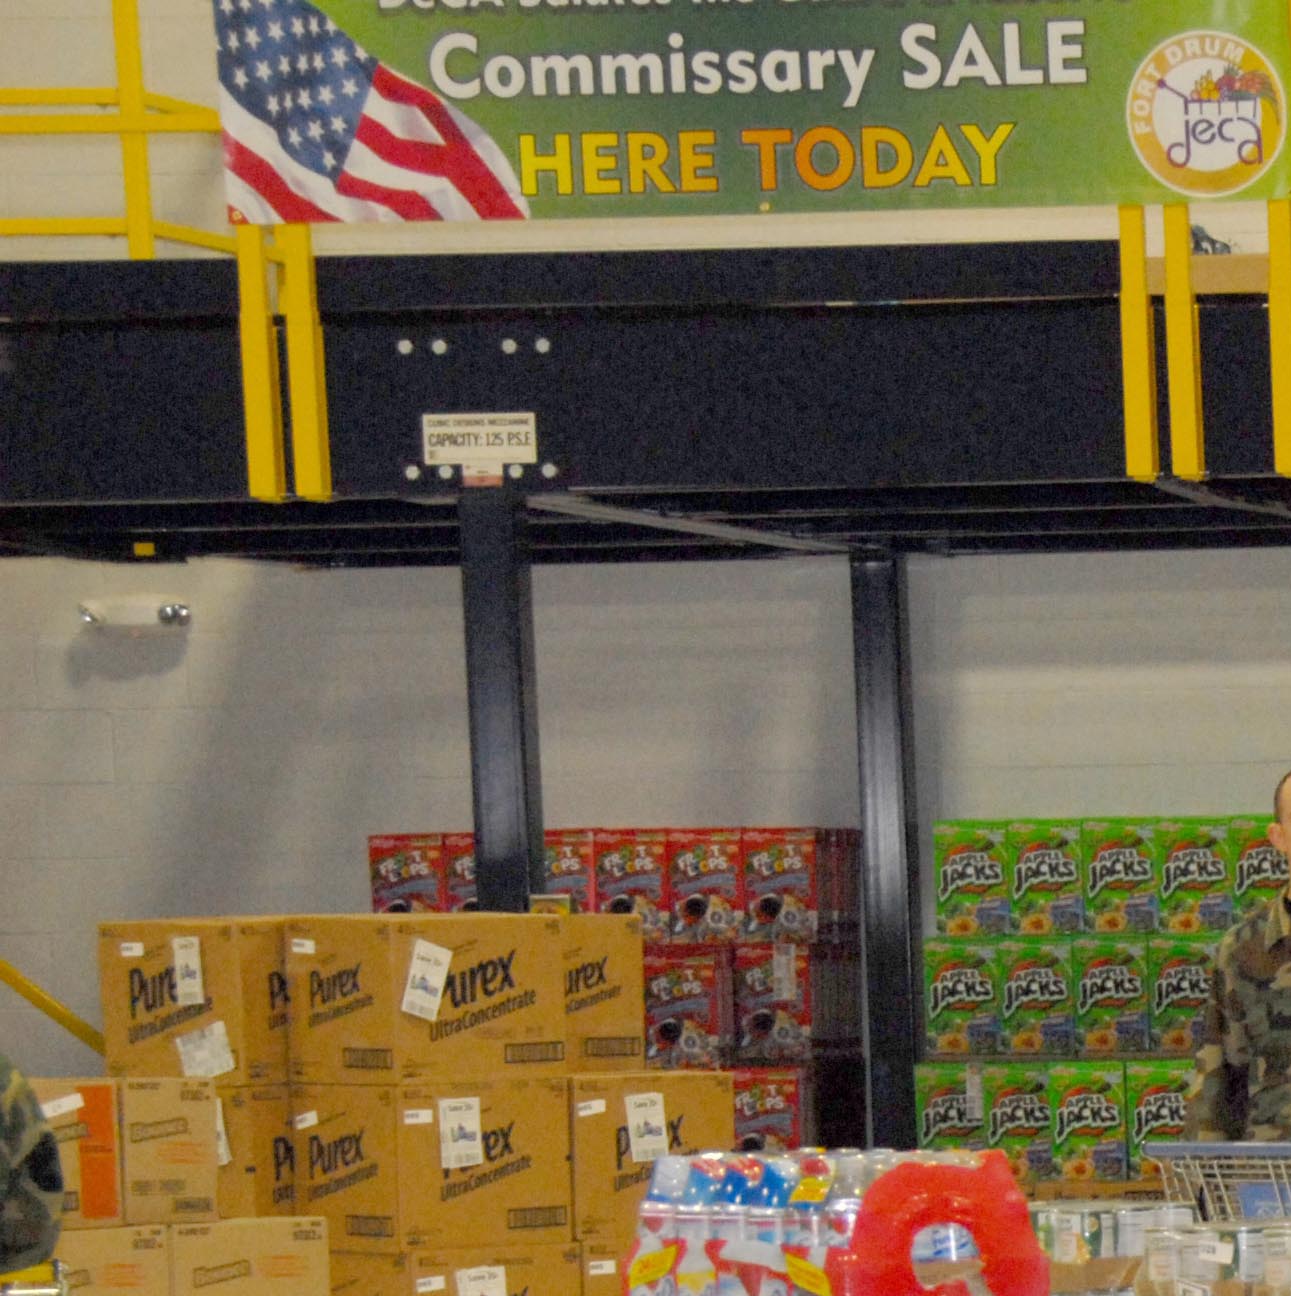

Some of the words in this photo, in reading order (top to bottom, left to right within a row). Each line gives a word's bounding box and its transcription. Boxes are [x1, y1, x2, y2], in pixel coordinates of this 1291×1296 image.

[429, 32, 875, 107] Commissary
[901, 20, 1088, 89] SALE
[1135, 63, 1160, 135] FORT
[1165, 36, 1245, 66] DRUM
[518, 129, 719, 196] HERE
[740, 122, 1017, 192] TODAY
[938, 860, 1002, 901] JACKS
[1012, 858, 1076, 900] JACKS
[1087, 857, 1153, 899] JACKS
[1159, 856, 1226, 898] JACKS
[128, 962, 178, 1019] Pure
[308, 963, 361, 1011] Purex
[444, 949, 516, 1009] urex
[928, 975, 995, 1020] JACKS
[1002, 975, 1068, 1019] JACKS
[1076, 974, 1143, 1019] JACKS
[429, 988, 537, 1043] UltraConcentrate
[985, 1101, 1050, 1146] JACKS
[1054, 1100, 1121, 1145] JACKS
[308, 1126, 365, 1174] Purex
[440, 1153, 532, 1202] UltraConcentrate
